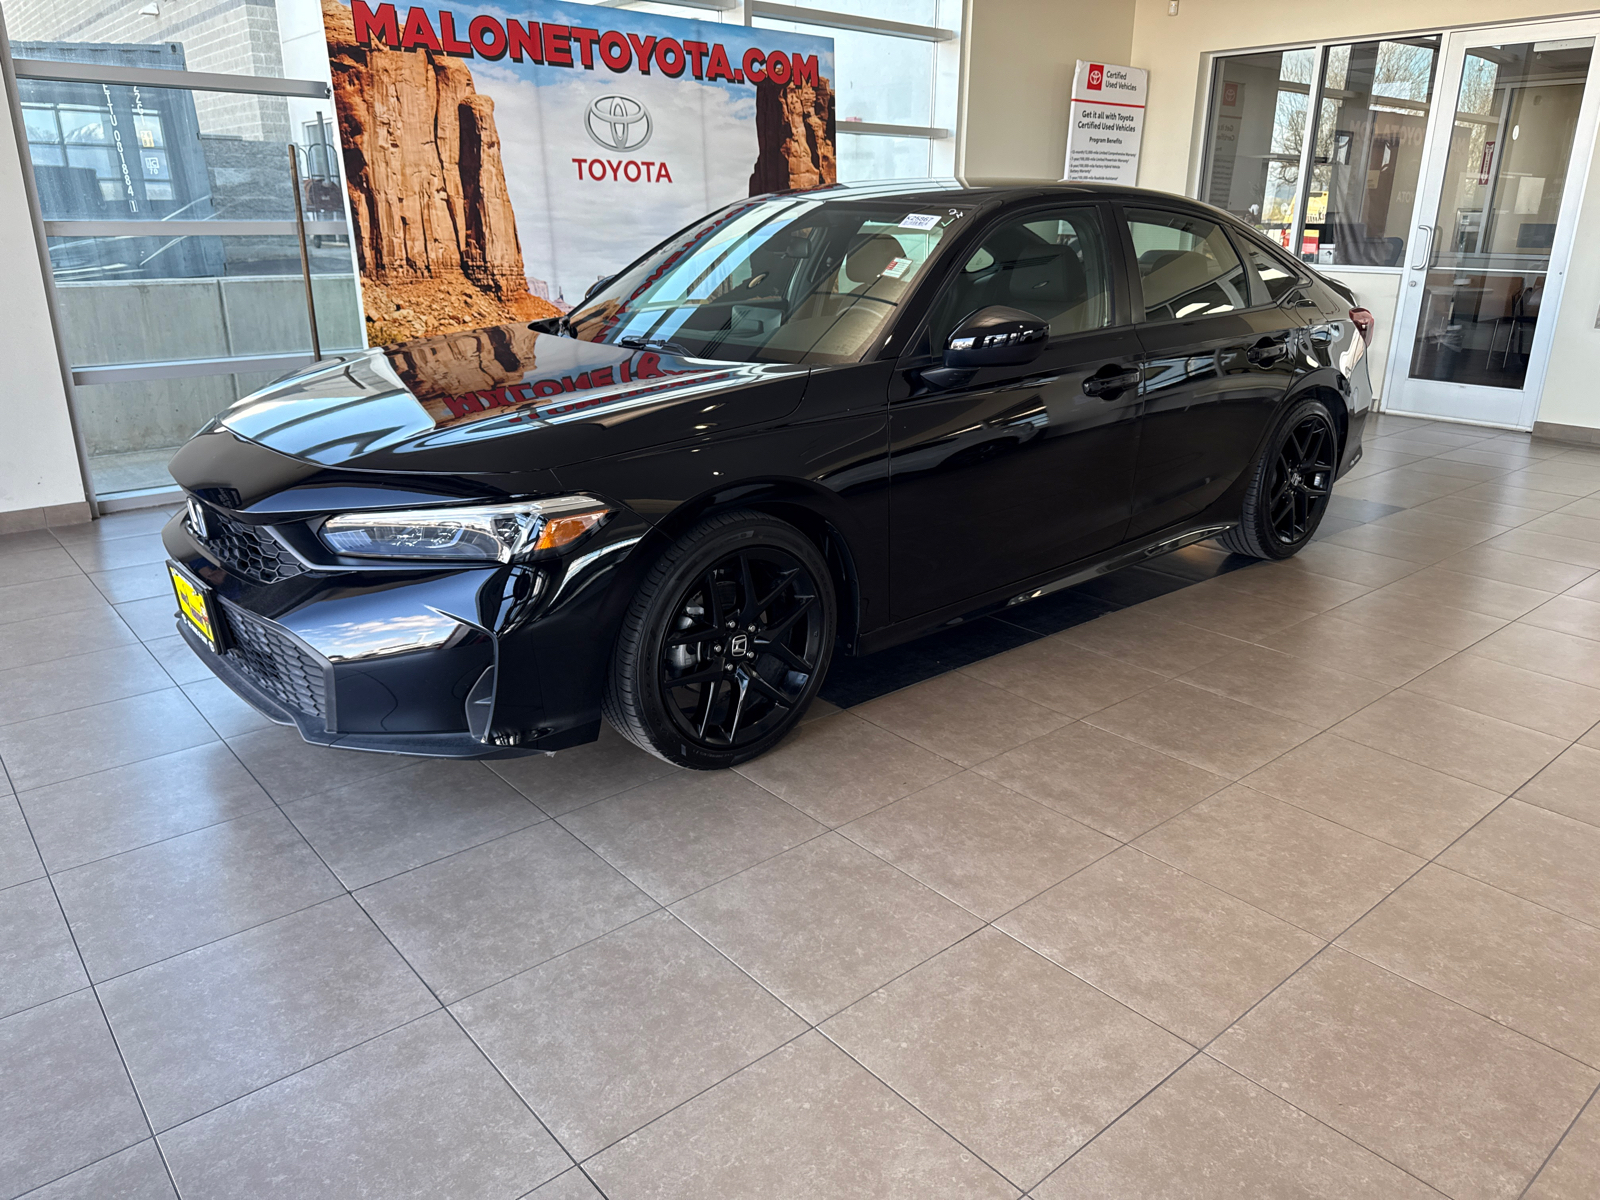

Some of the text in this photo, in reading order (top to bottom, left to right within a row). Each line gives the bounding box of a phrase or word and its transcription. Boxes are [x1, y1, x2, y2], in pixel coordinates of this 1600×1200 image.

[351, 0, 819, 88] MALONETOYOTA.COM
[1106, 70, 1127, 80] Certified
[1105, 81, 1137, 91] Used Vehicles
[1082, 110, 1134, 123] Get it all with Toyota
[1077, 120, 1136, 133] Certified Used Vehicles
[1089, 136, 1123, 145] Program Benefits
[572, 158, 673, 184] TOYOTA
